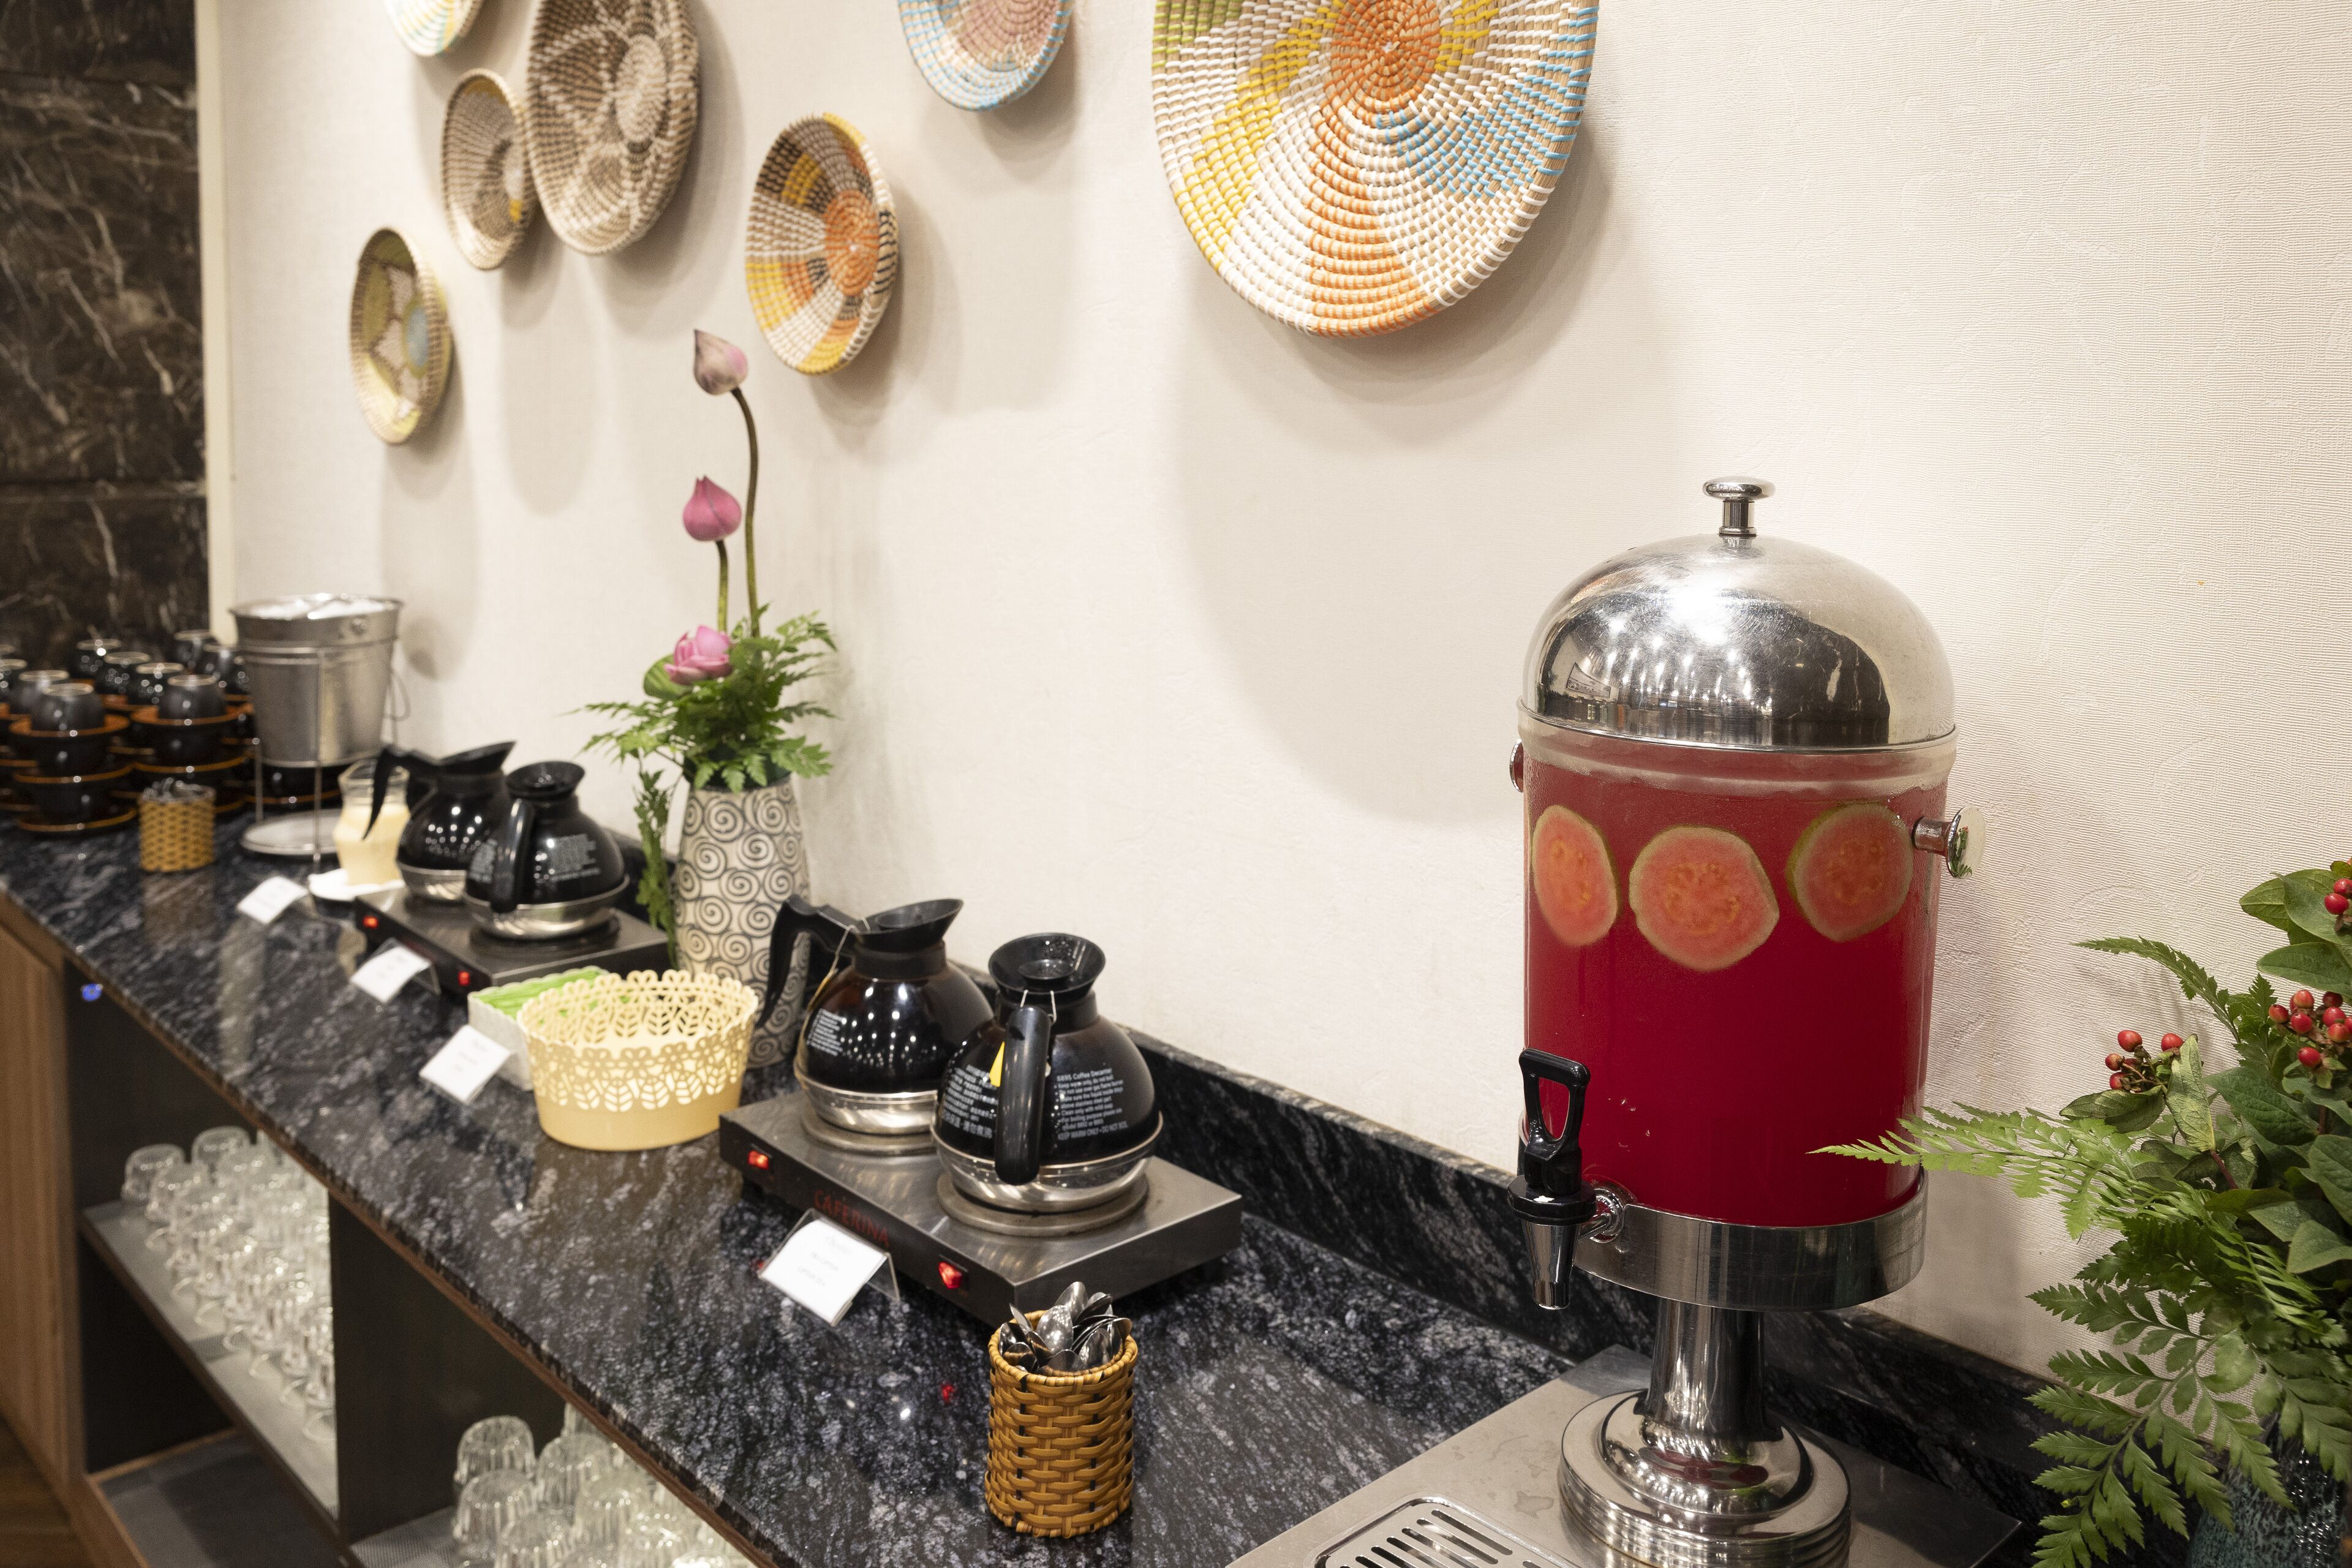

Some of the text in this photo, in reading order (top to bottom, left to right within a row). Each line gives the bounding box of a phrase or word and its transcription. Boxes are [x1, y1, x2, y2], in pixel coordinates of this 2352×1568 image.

[1072, 1071, 1090, 1080] Coffee
[1090, 1068, 1112, 1077] Decanter
[813, 1189, 890, 1248] CAFERINA
